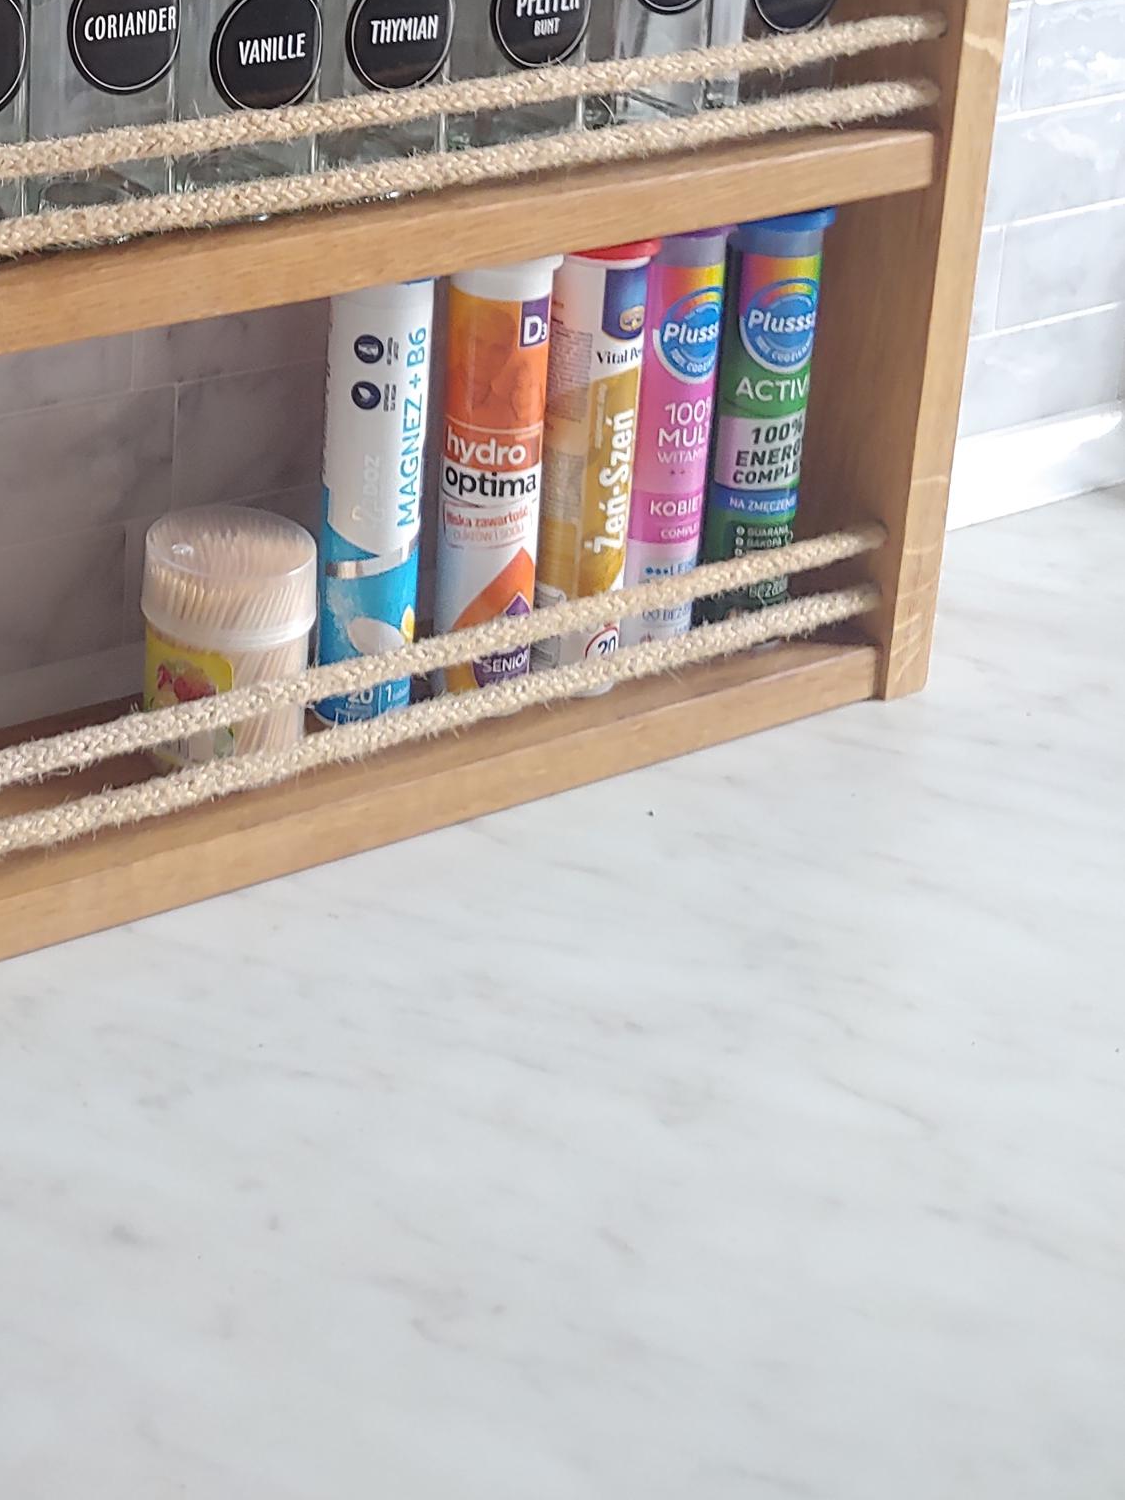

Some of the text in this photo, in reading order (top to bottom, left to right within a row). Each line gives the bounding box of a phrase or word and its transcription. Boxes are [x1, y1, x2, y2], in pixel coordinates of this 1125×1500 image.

[84, 6, 177, 42] CORIANDER
[371, 14, 439, 45] THYMIAN
[533, 18, 560, 37] BUNT
[239, 32, 306, 66] VANILLE
[407, 327, 426, 367] B6
[596, 349, 627, 364] Vital
[398, 393, 422, 527] MAGNEZ
[447, 425, 526, 467] hydro
[445, 466, 536, 497] optima
